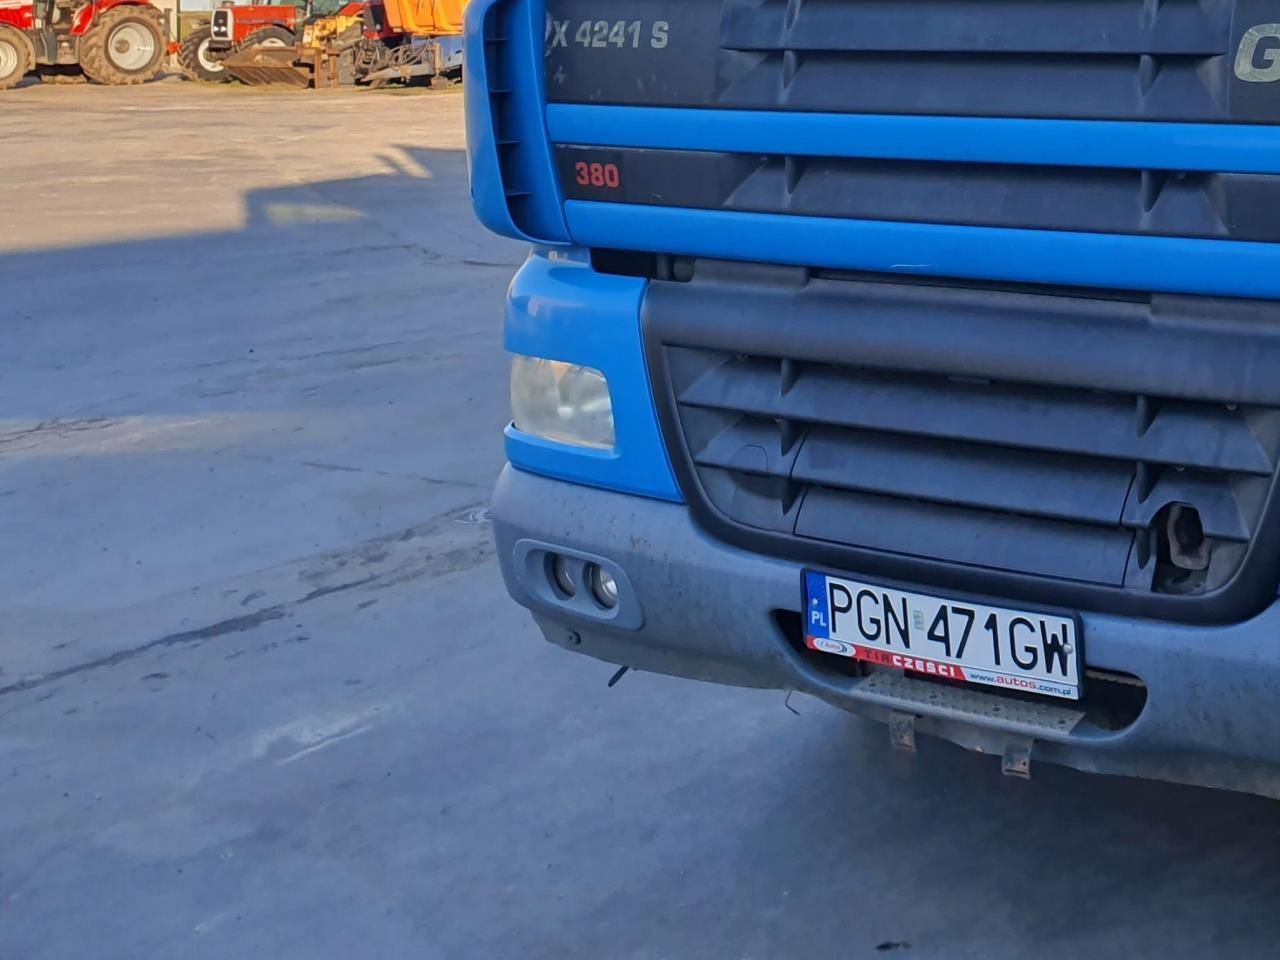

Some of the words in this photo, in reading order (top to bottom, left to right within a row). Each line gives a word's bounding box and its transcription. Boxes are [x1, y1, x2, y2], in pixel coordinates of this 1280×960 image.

[575, 20, 642, 48] 4241
[650, 20, 670, 49] S
[575, 161, 619, 187] 380
[811, 610, 827, 627] PL
[829, 582, 911, 649] PGN
[927, 604, 1069, 676] 471GW
[970, 673, 1072, 695] www.autos.com.pl
